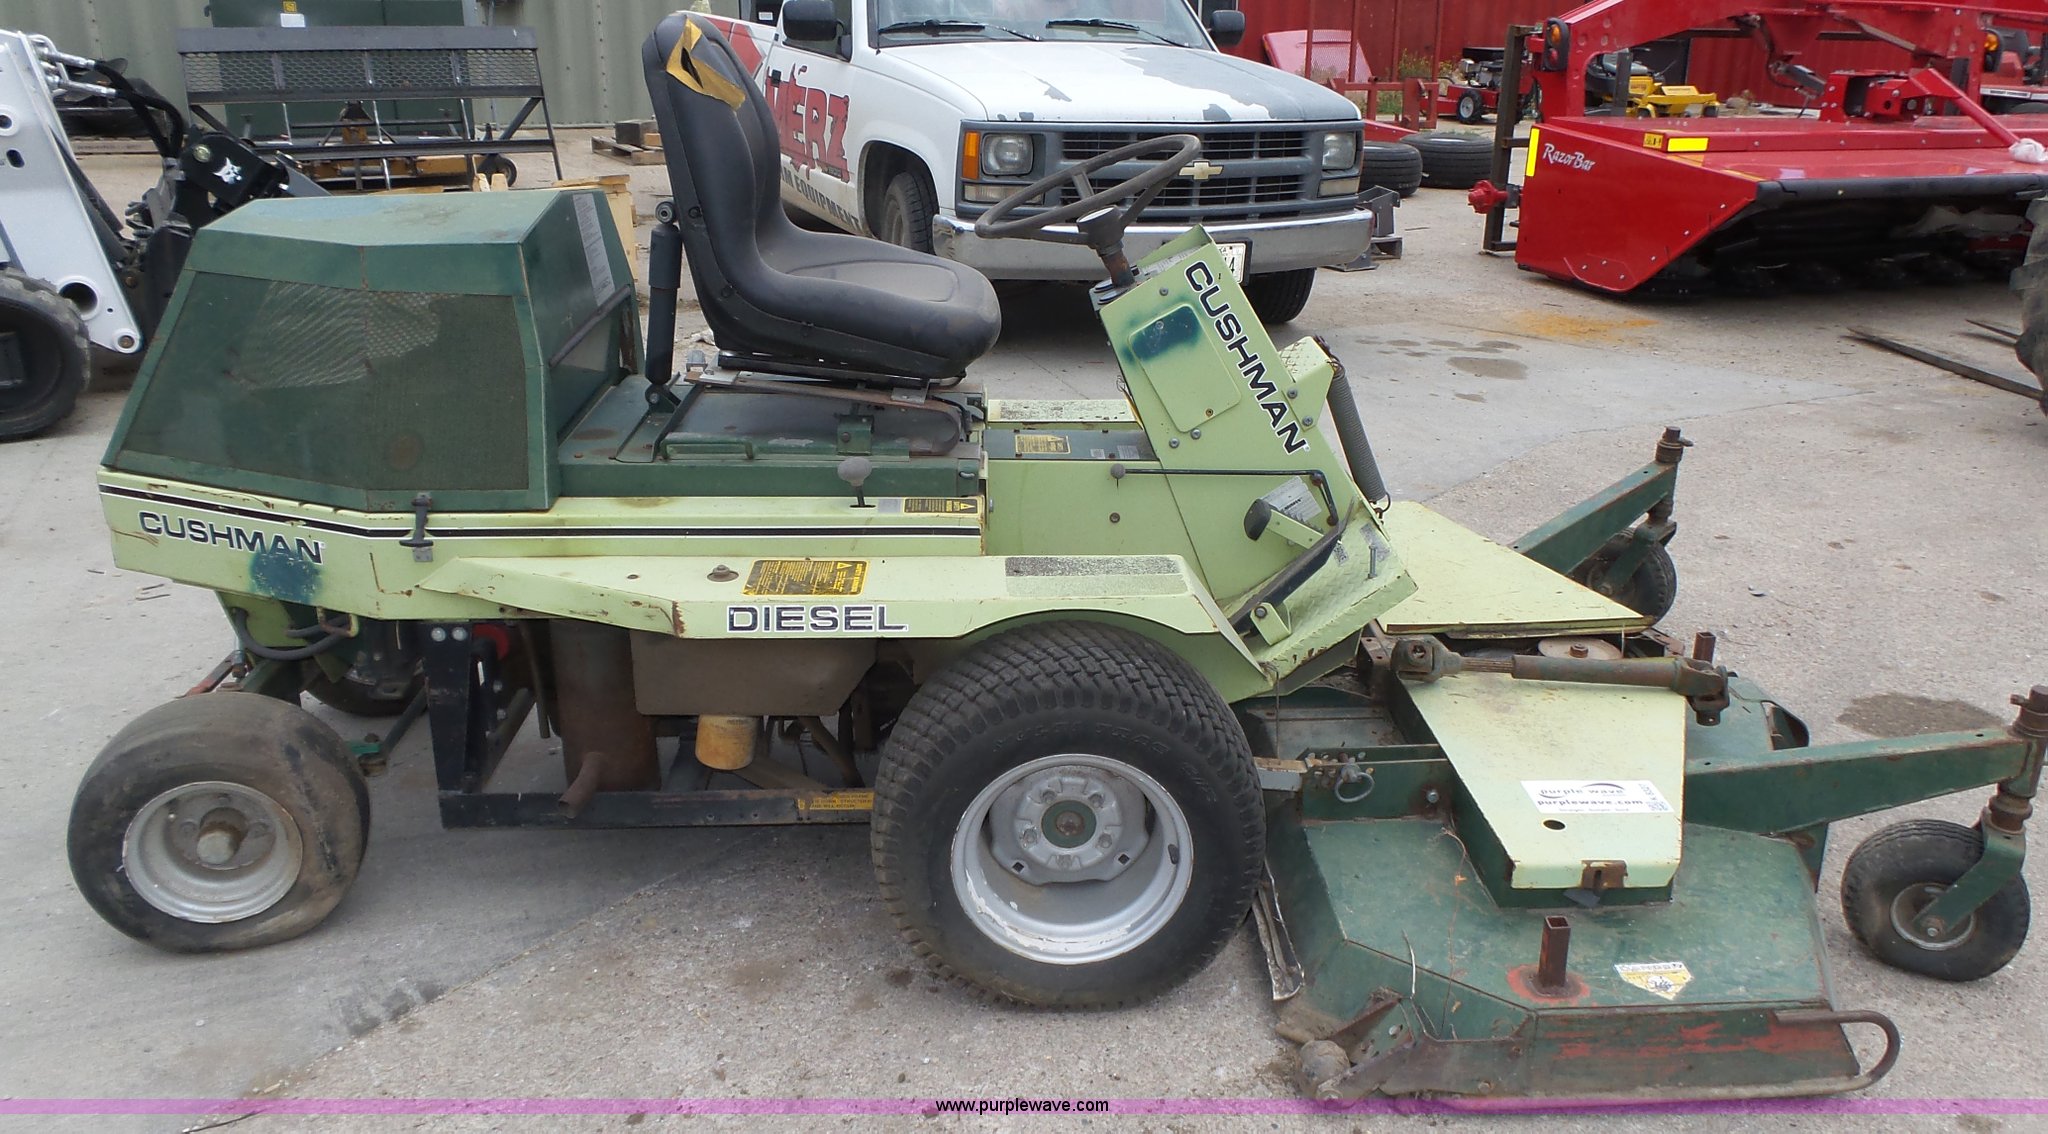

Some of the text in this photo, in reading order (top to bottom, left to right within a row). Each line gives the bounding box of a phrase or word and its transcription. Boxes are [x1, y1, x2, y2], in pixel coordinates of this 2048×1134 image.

[1542, 143, 1596, 171] RazorBar
[795, 173, 863, 232] EQUIPMENT
[1184, 260, 1307, 455] CUSHMAN
[138, 511, 324, 564] CUSHMAN
[727, 605, 909, 632] DIESEL
